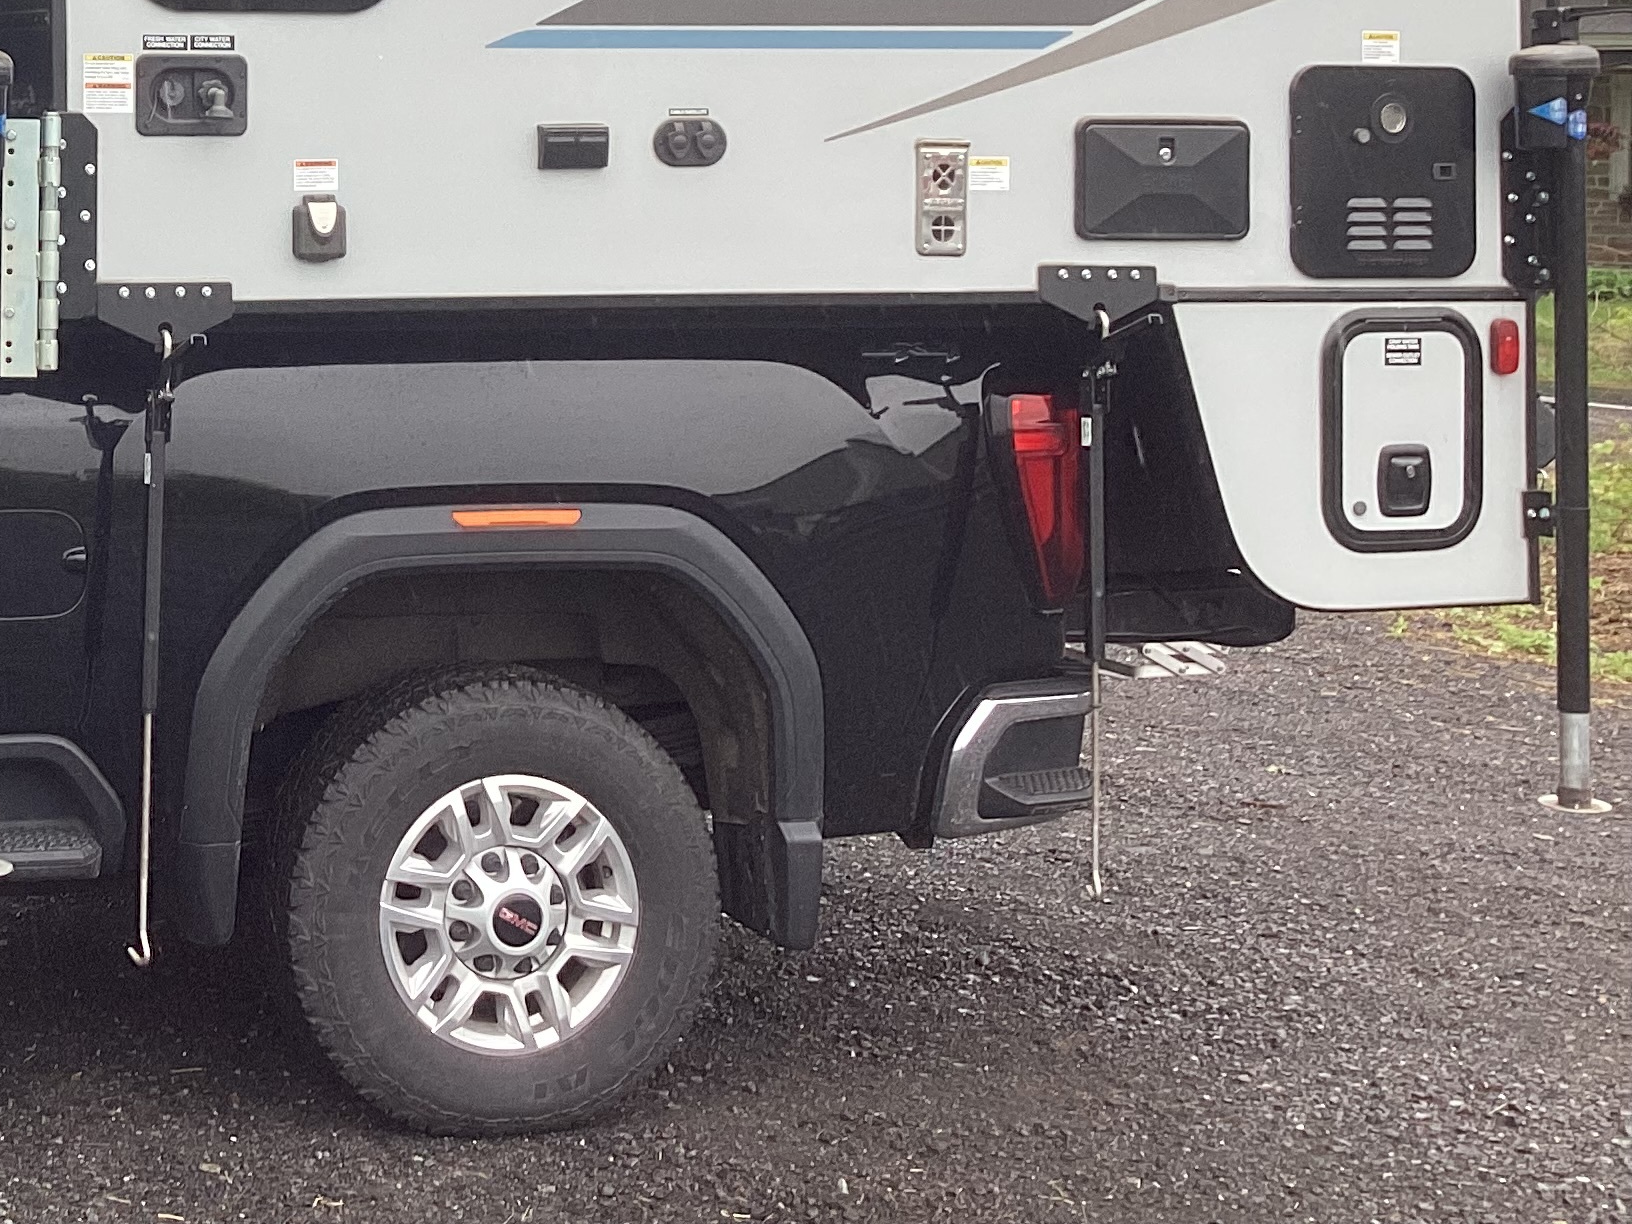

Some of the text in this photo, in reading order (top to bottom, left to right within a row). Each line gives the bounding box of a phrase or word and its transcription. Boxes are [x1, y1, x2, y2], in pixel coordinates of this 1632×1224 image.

[145, 41, 185, 49] CONNECTION
[193, 41, 232, 49] CONNECTION
[499, 907, 538, 936] GMC
